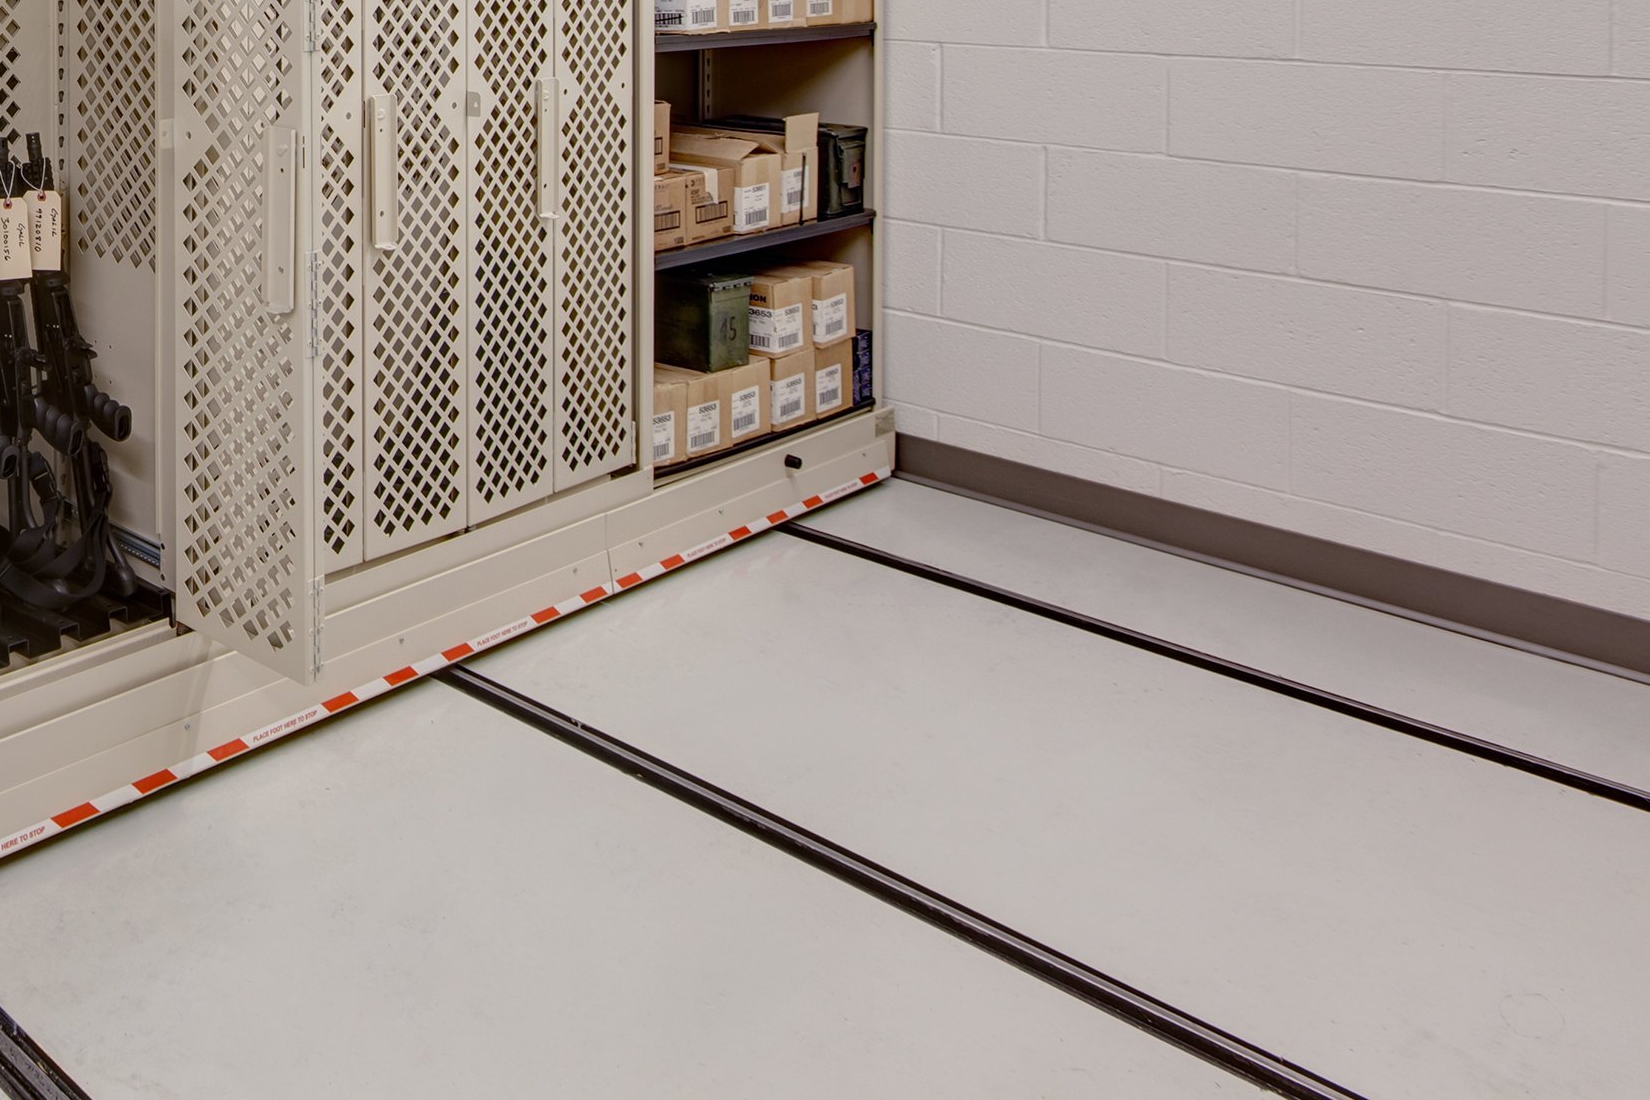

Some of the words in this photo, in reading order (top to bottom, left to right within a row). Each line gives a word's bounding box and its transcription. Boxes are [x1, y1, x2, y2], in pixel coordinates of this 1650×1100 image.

[1, 217, 11, 261] 30100156
[252, 730, 269, 743] PLACE
[270, 724, 283, 735] FOOT
[283, 718, 297, 729] HERE
[297, 715, 305, 723] TO
[305, 710, 318, 720] STOP
[1, 837, 19, 850] HERE
[19, 833, 28, 842] TO
[29, 826, 46, 839] STOP
